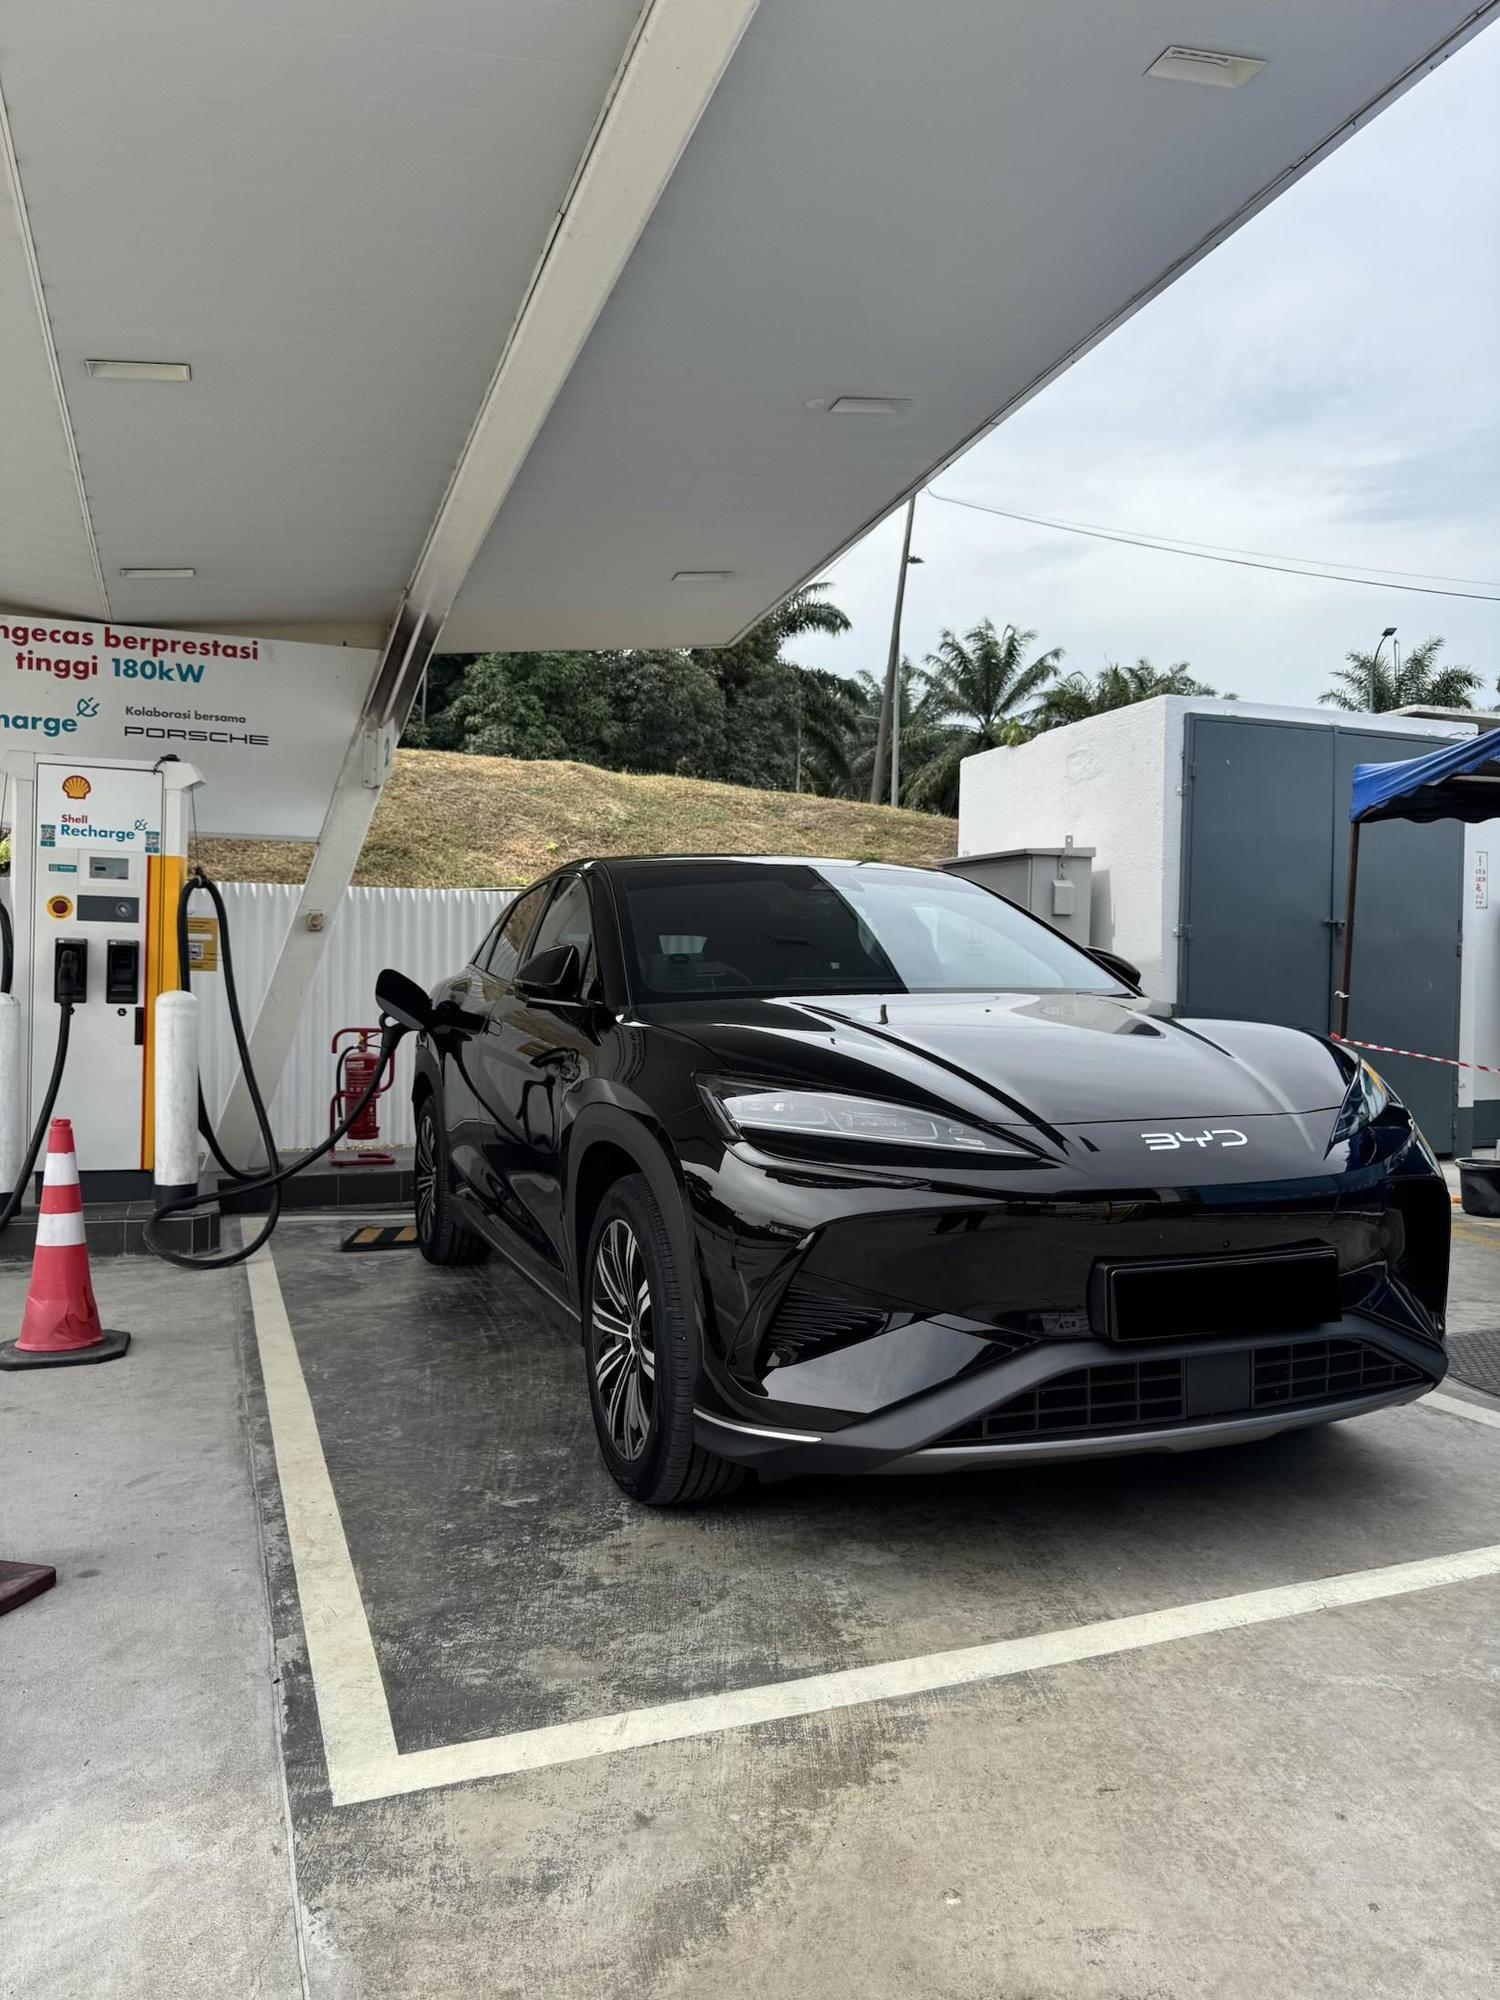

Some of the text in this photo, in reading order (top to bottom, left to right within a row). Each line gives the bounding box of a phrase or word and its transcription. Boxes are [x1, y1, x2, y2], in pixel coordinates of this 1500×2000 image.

[104, 626, 259, 660] berprestasi
[16, 650, 205, 684] tinggi 180kW
[125, 706, 246, 724] Kolaborasi bersama
[124, 726, 269, 746] PORSCHE
[61, 814, 88, 824] Shell
[61, 824, 136, 842] Recharge
[1140, 1129, 1248, 1151] BYD
